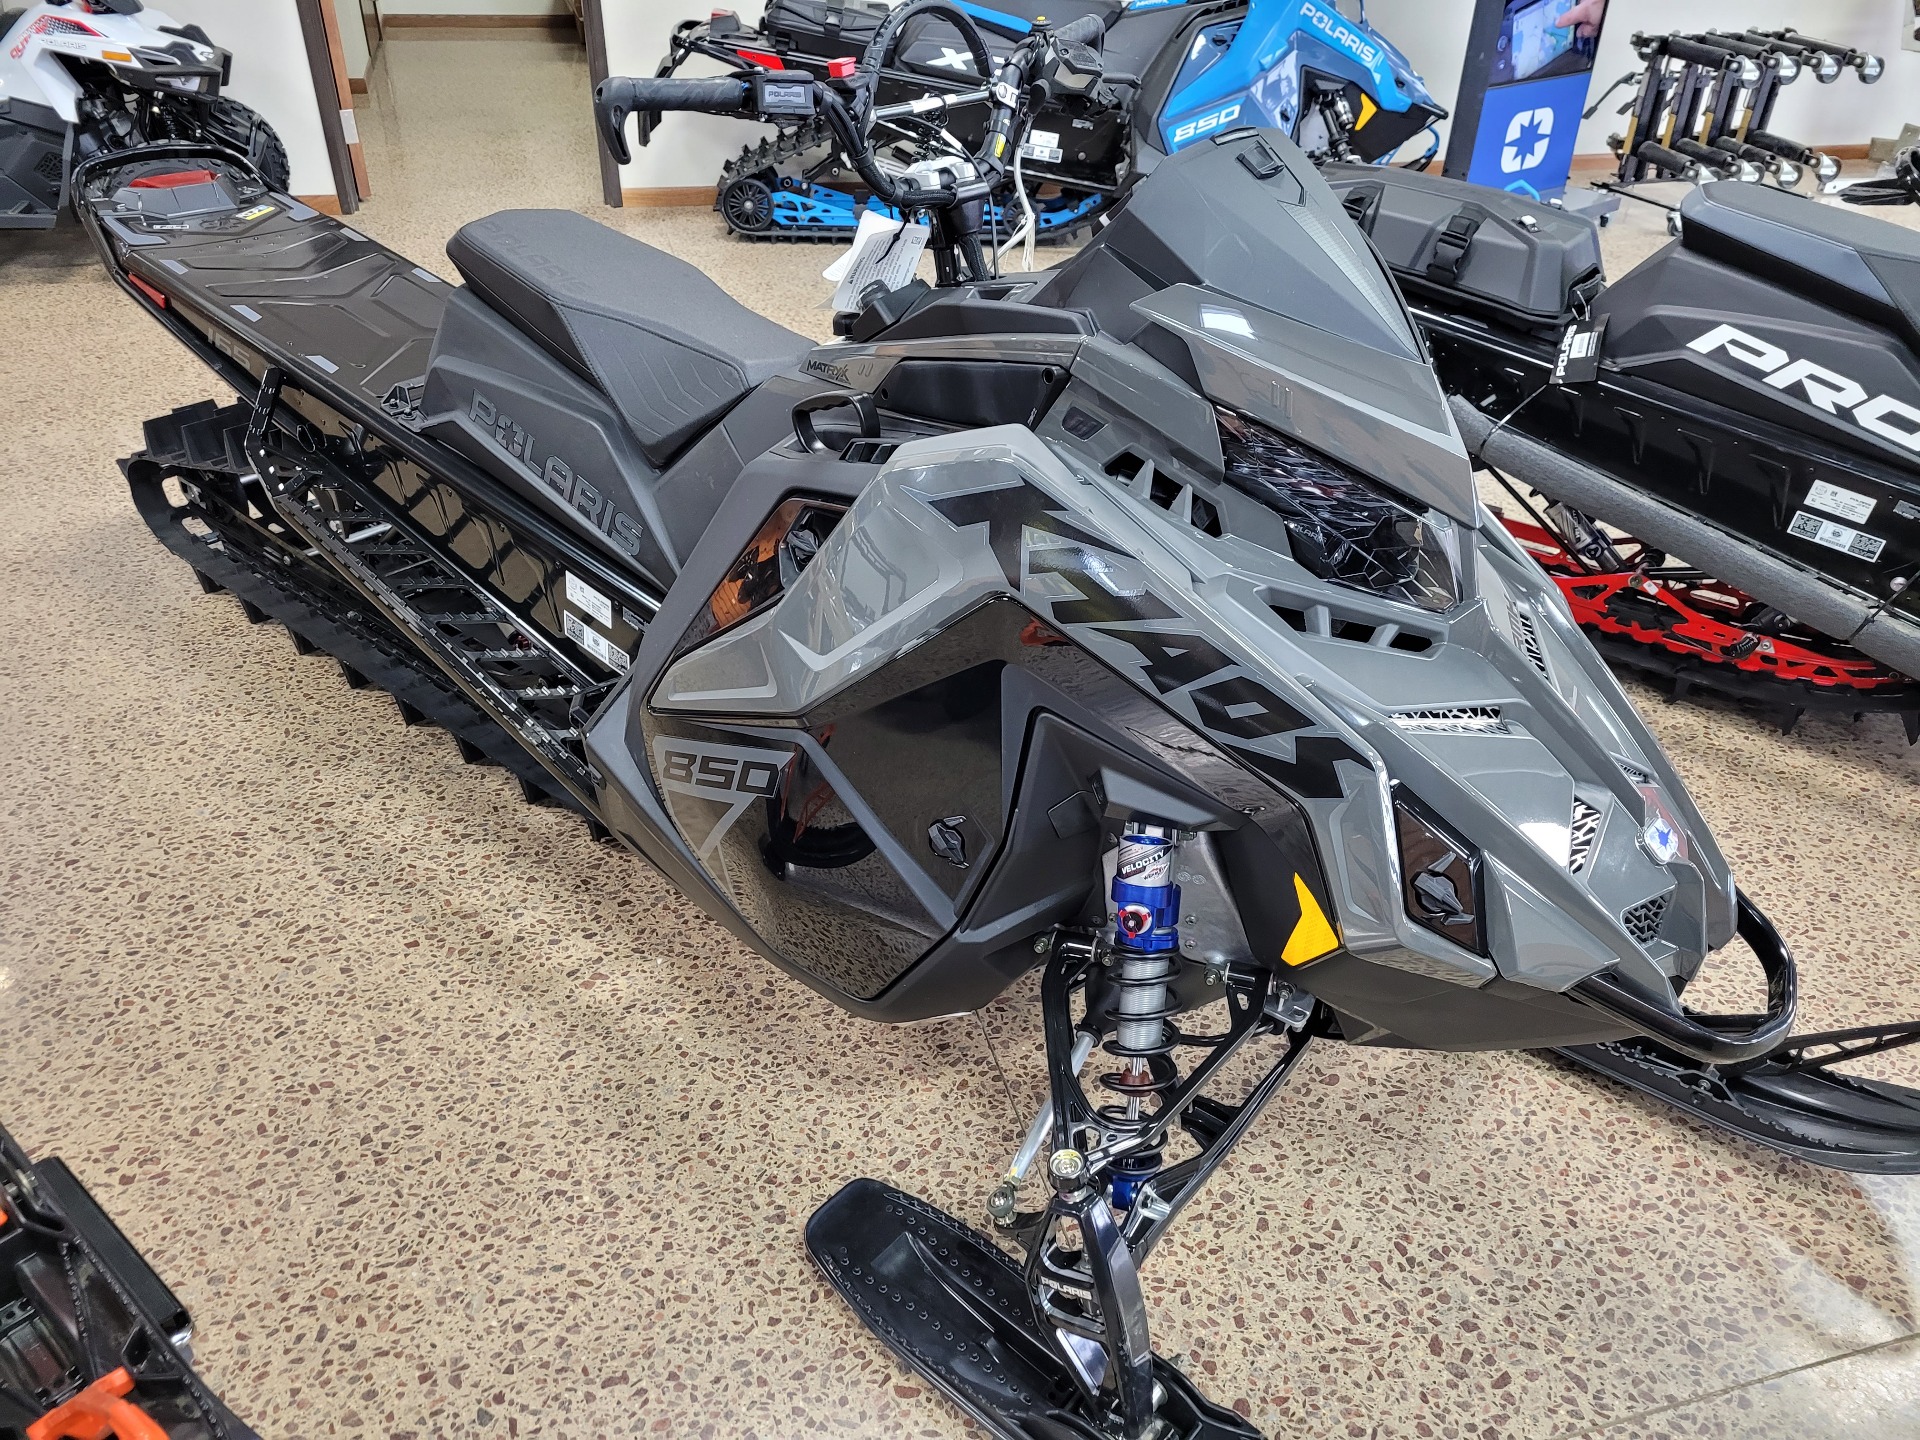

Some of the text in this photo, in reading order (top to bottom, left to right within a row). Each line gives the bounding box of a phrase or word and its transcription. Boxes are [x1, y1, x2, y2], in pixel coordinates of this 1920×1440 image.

[40, 39, 87, 50] POLARIS
[1300, 3, 1376, 63] POLARIS
[768, 90, 802, 98] POLARIS
[1173, 104, 1241, 143] 850
[208, 328, 250, 371] 155
[1556, 325, 1577, 376] POLARIS
[807, 360, 850, 382] MATRYX
[469, 388, 644, 557] POLARIS
[929, 474, 1375, 799] KHAOS
[663, 749, 780, 797] 850
[1121, 849, 1165, 875] VELOCITY
[1041, 1276, 1093, 1301] POLARIS
